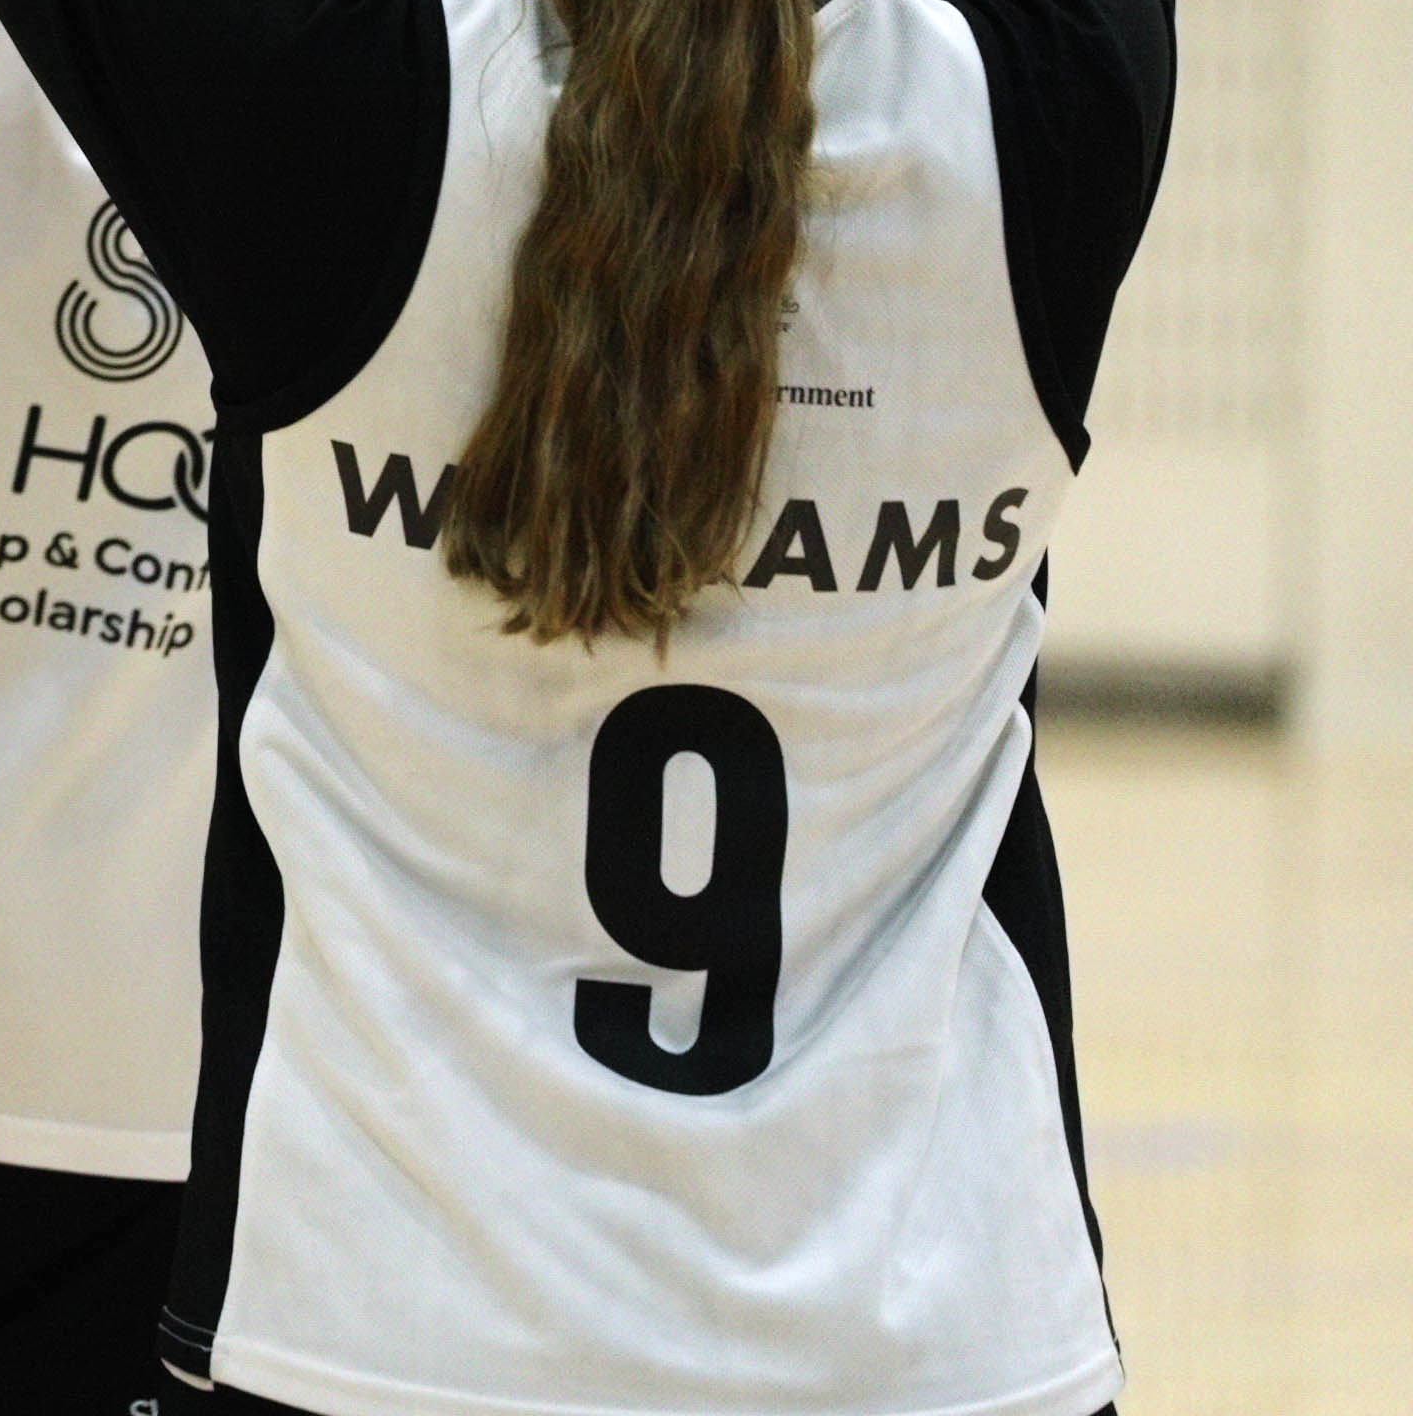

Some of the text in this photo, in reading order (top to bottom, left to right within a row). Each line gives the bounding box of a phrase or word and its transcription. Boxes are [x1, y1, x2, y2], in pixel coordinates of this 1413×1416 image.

[777, 385, 876, 408] rnment
[44, 532, 79, 570] &
[331, 439, 1029, 592] WAMS
[574, 683, 788, 1096] 9
